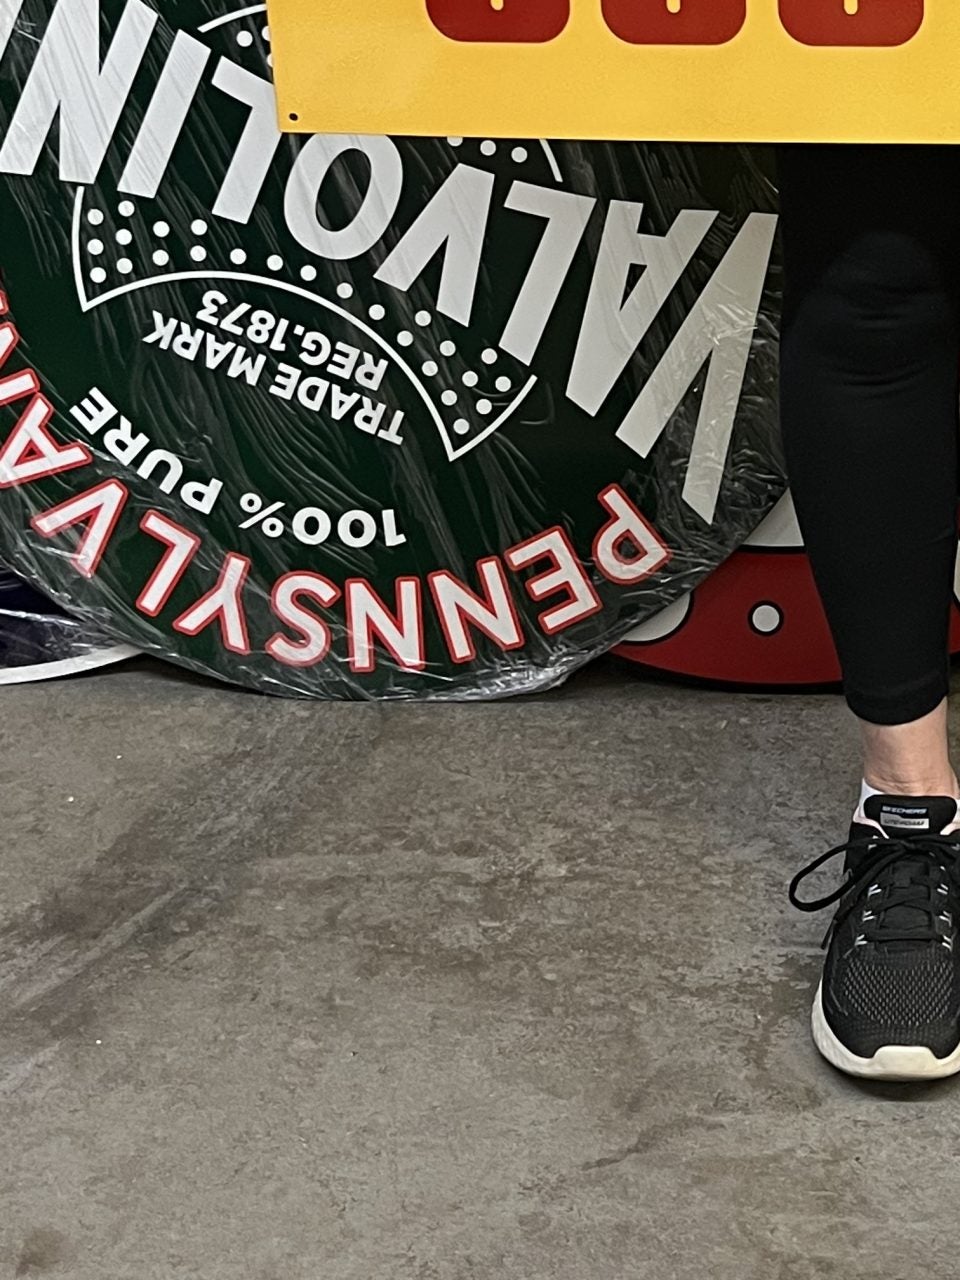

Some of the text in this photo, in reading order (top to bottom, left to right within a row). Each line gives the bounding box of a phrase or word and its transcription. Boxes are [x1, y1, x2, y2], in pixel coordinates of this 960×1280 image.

[142, 310, 405, 445] TRADE MARK
[196, 289, 389, 391] REG.1873
[68, 386, 407, 549] 100% PURE
